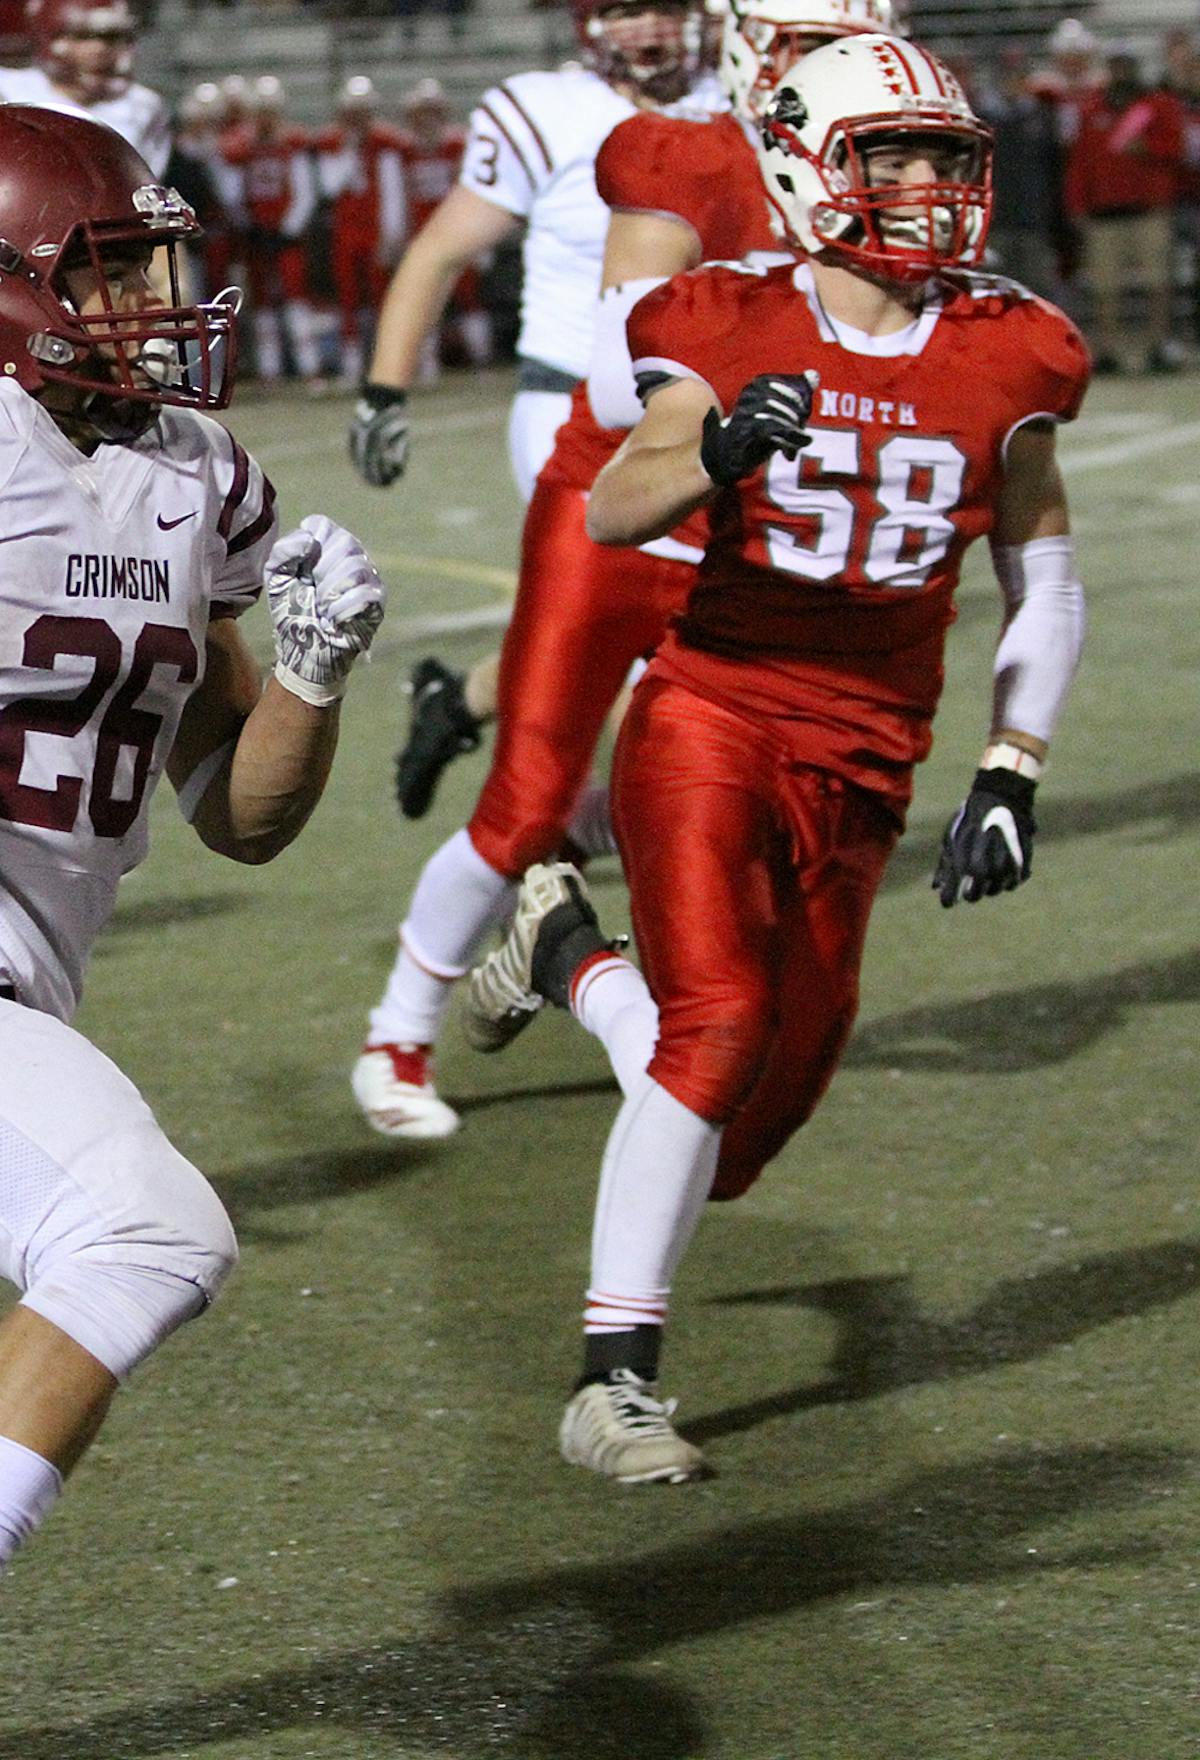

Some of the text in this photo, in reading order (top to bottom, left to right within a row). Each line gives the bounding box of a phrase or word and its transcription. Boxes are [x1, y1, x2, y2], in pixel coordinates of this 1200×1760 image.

[819, 389, 918, 426] NORTH
[766, 425, 967, 587] 58
[65, 554, 171, 604] CRIMSON
